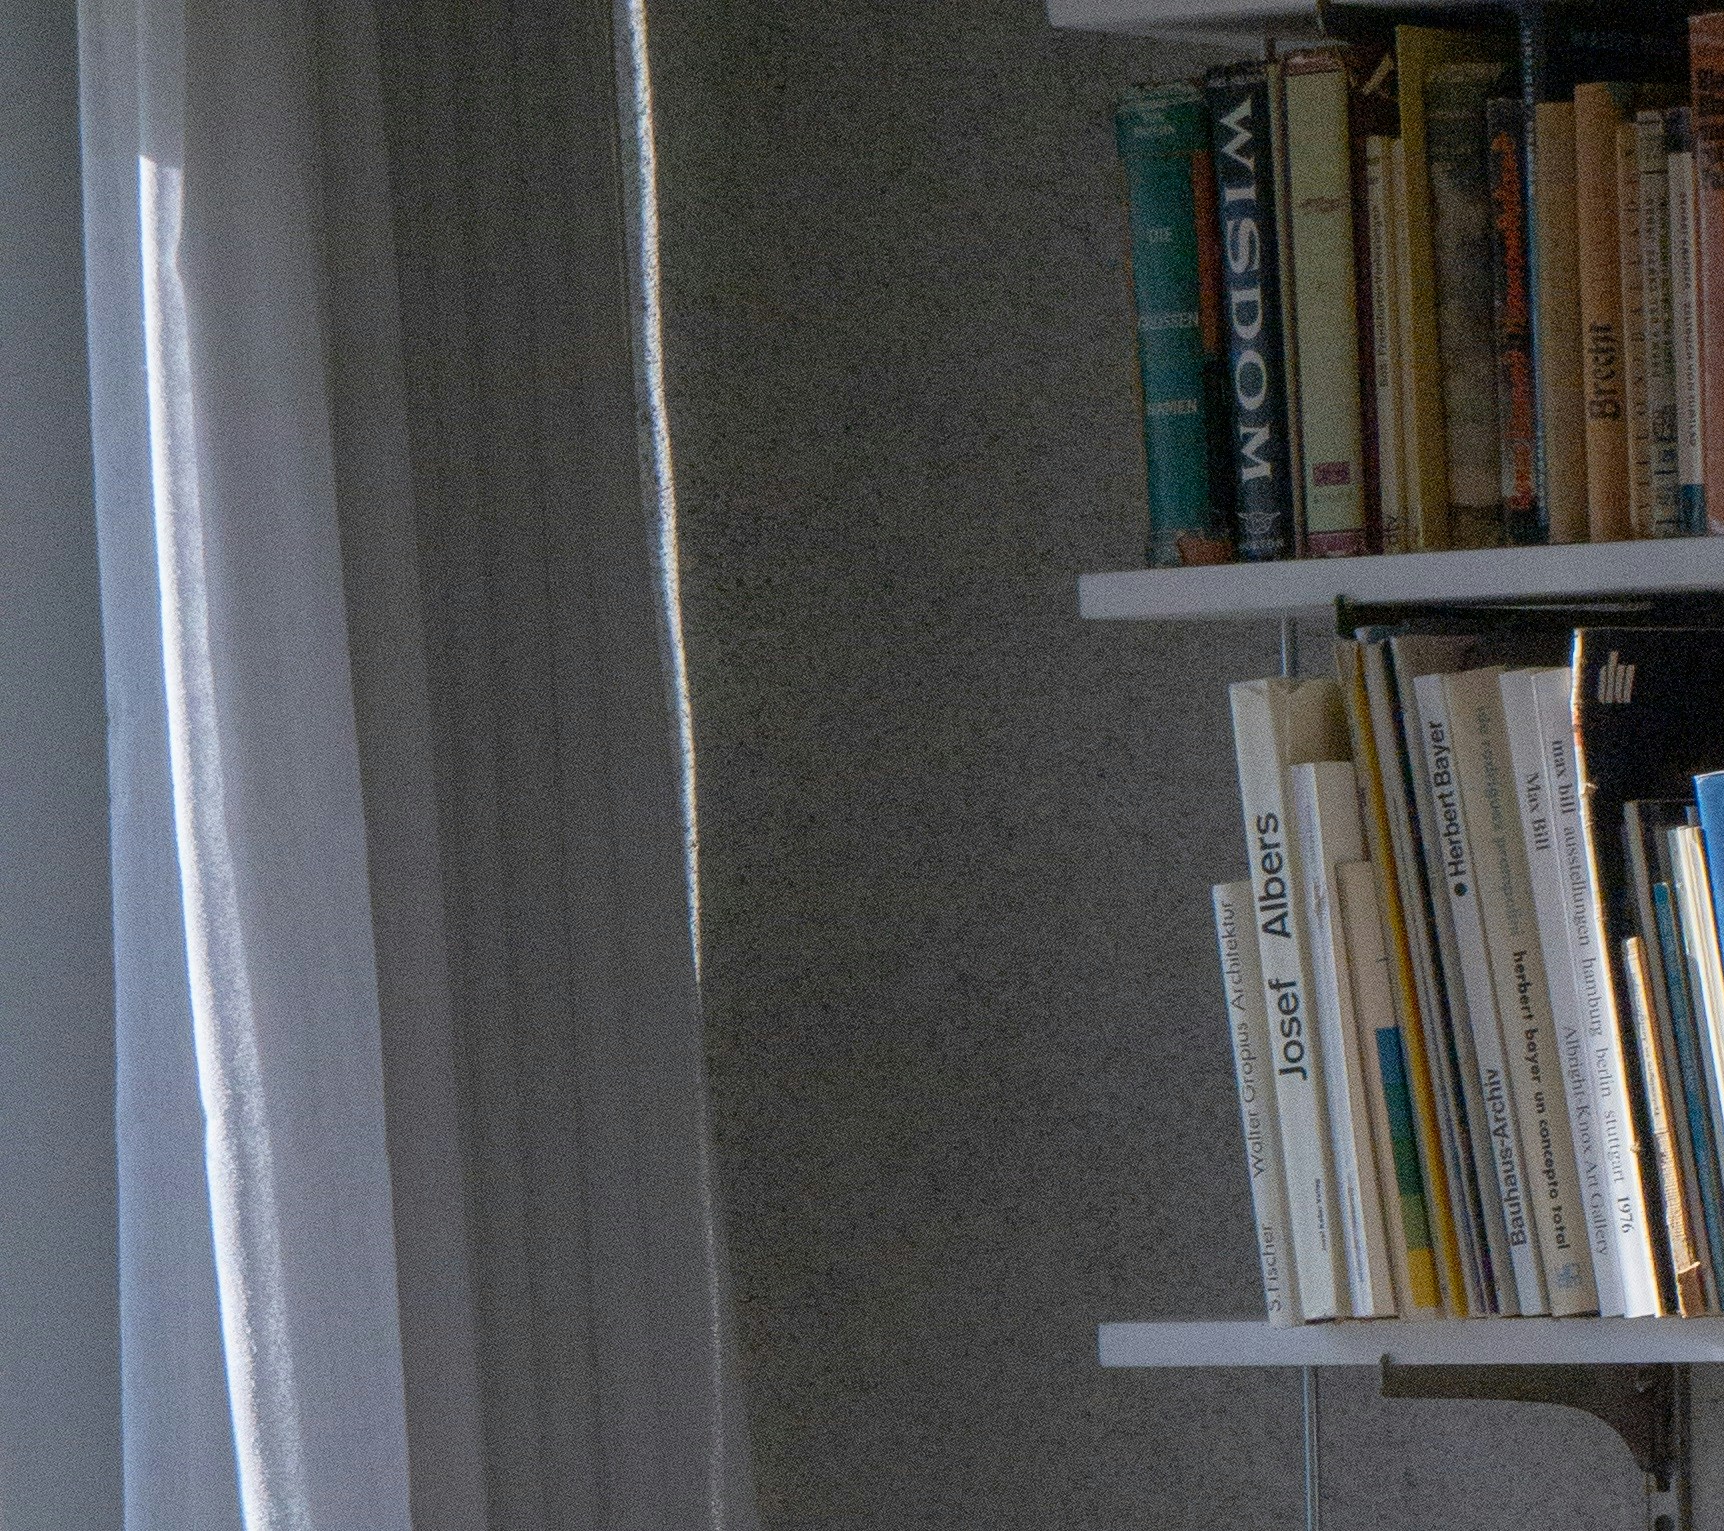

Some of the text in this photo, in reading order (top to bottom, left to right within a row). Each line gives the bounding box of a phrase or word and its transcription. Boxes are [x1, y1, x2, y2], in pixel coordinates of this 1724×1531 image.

[1219, 97, 1272, 483] WISDOM
[1428, 722, 1467, 876] Herbert Bayer
[1524, 772, 1550, 852] Max Bill
[1219, 900, 1265, 1179] Walter Gropius Architektur
[1254, 812, 1308, 1081] Josef Albers
[1553, 739, 1634, 1234] max bill ausstellungen hamburg berlin stuttgart 1976
[1486, 1068, 1528, 1246] Bauhaus-Archiv
[1513, 950, 1570, 1250] herbert bayer un concepto total
[1581, 1159, 1602, 1189] Art
[1589, 1192, 1612, 1256] Gallery
